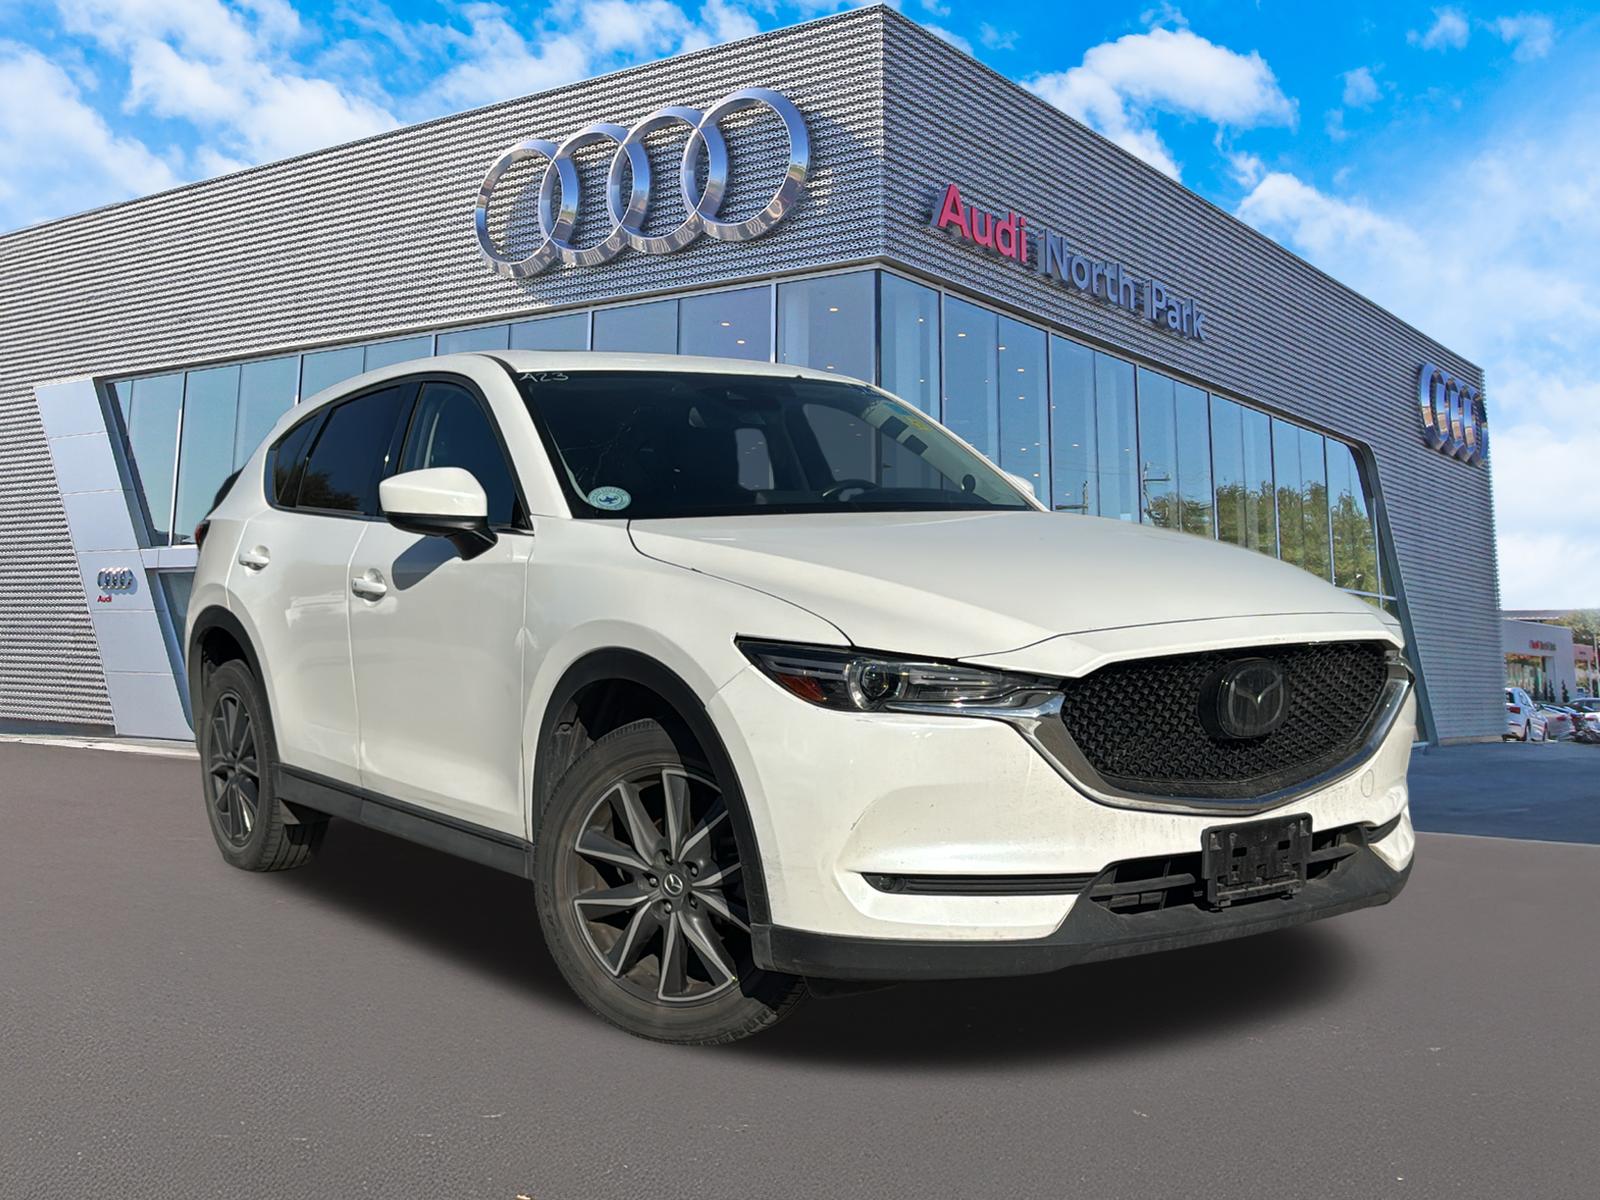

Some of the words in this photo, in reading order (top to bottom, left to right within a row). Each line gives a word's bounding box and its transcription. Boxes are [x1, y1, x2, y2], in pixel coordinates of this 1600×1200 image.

[931, 183, 1028, 263] Audi
[1038, 228, 1136, 310] North
[1145, 278, 1207, 341] Park
